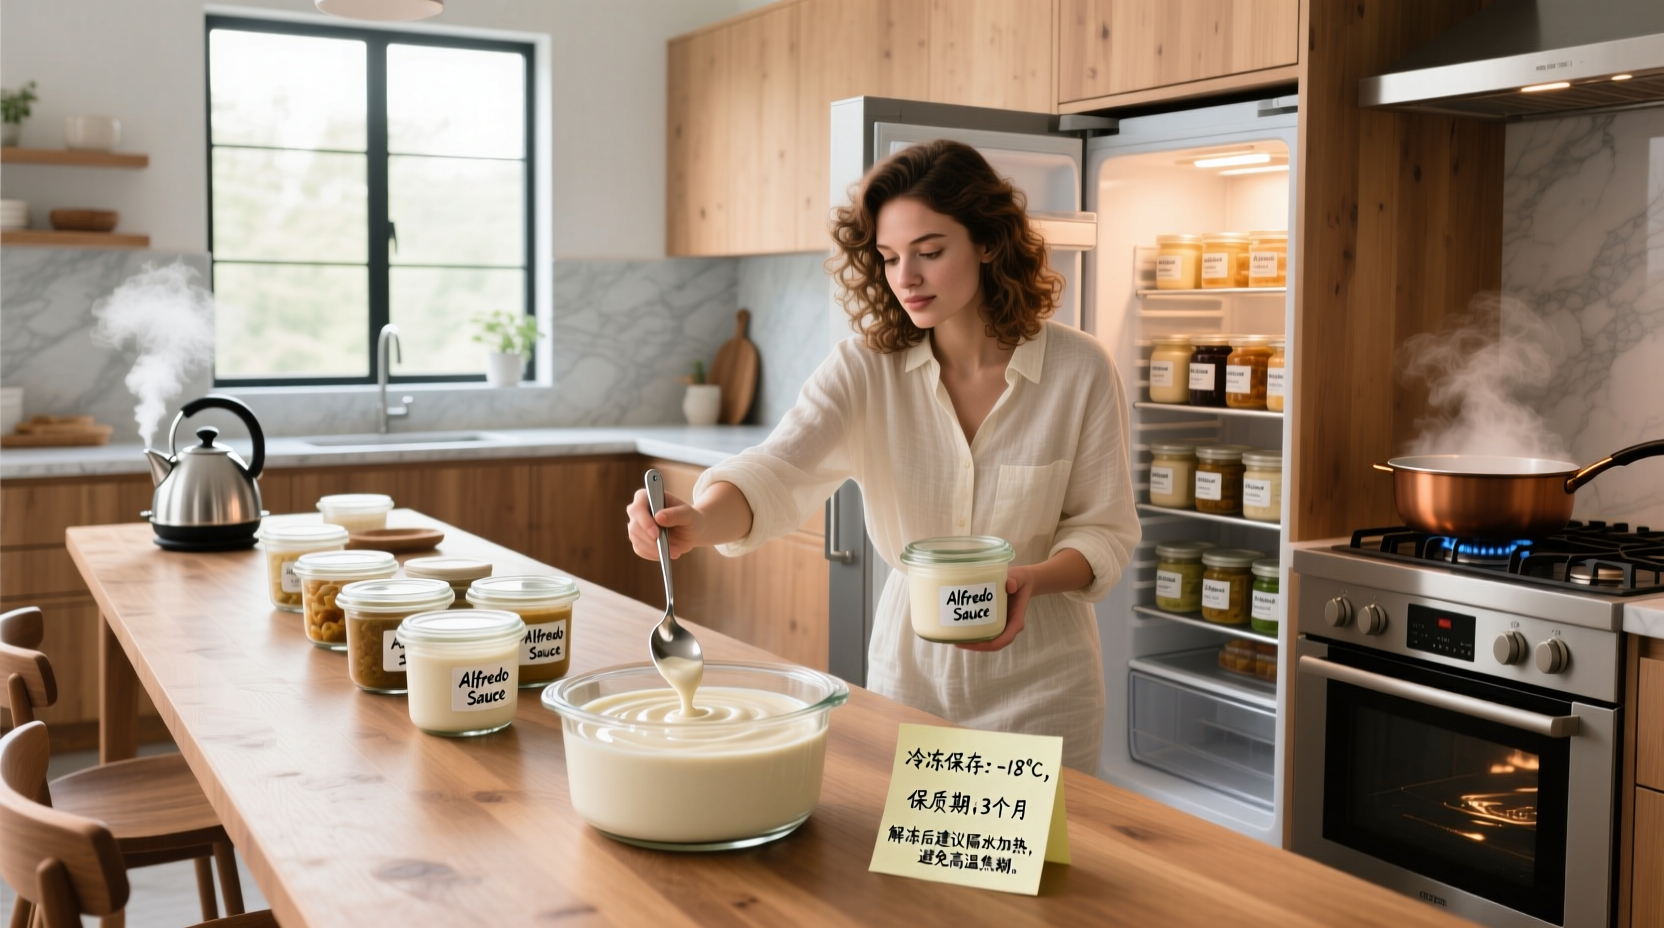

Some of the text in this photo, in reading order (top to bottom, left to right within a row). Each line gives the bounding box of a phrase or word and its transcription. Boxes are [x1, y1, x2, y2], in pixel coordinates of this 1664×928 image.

[947, 588, 993, 606] Alfredo
[954, 608, 990, 621] Sauce
[524, 626, 563, 645] Alfredo
[529, 646, 561, 660] Sauce
[459, 667, 509, 689] Alfredo
[467, 689, 505, 706] Sauce
